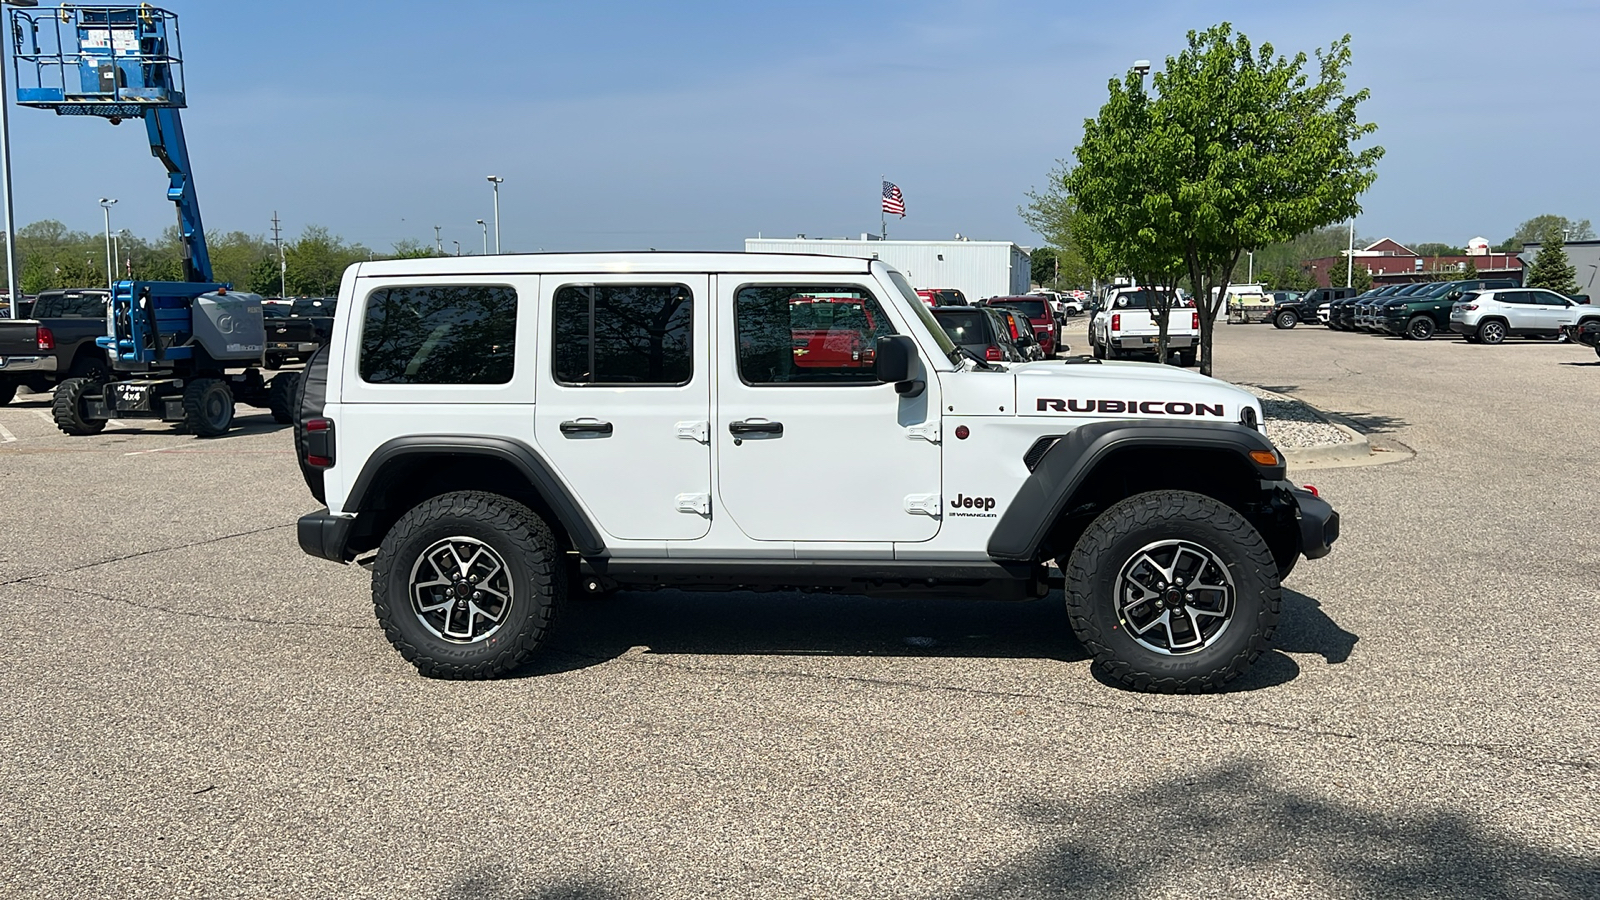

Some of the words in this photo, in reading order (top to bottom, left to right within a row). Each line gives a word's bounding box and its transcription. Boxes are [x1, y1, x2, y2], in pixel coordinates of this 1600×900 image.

[122, 392, 141, 400] 4x4
[1037, 398, 1225, 416] RUBICON
[951, 493, 996, 511] Jeep
